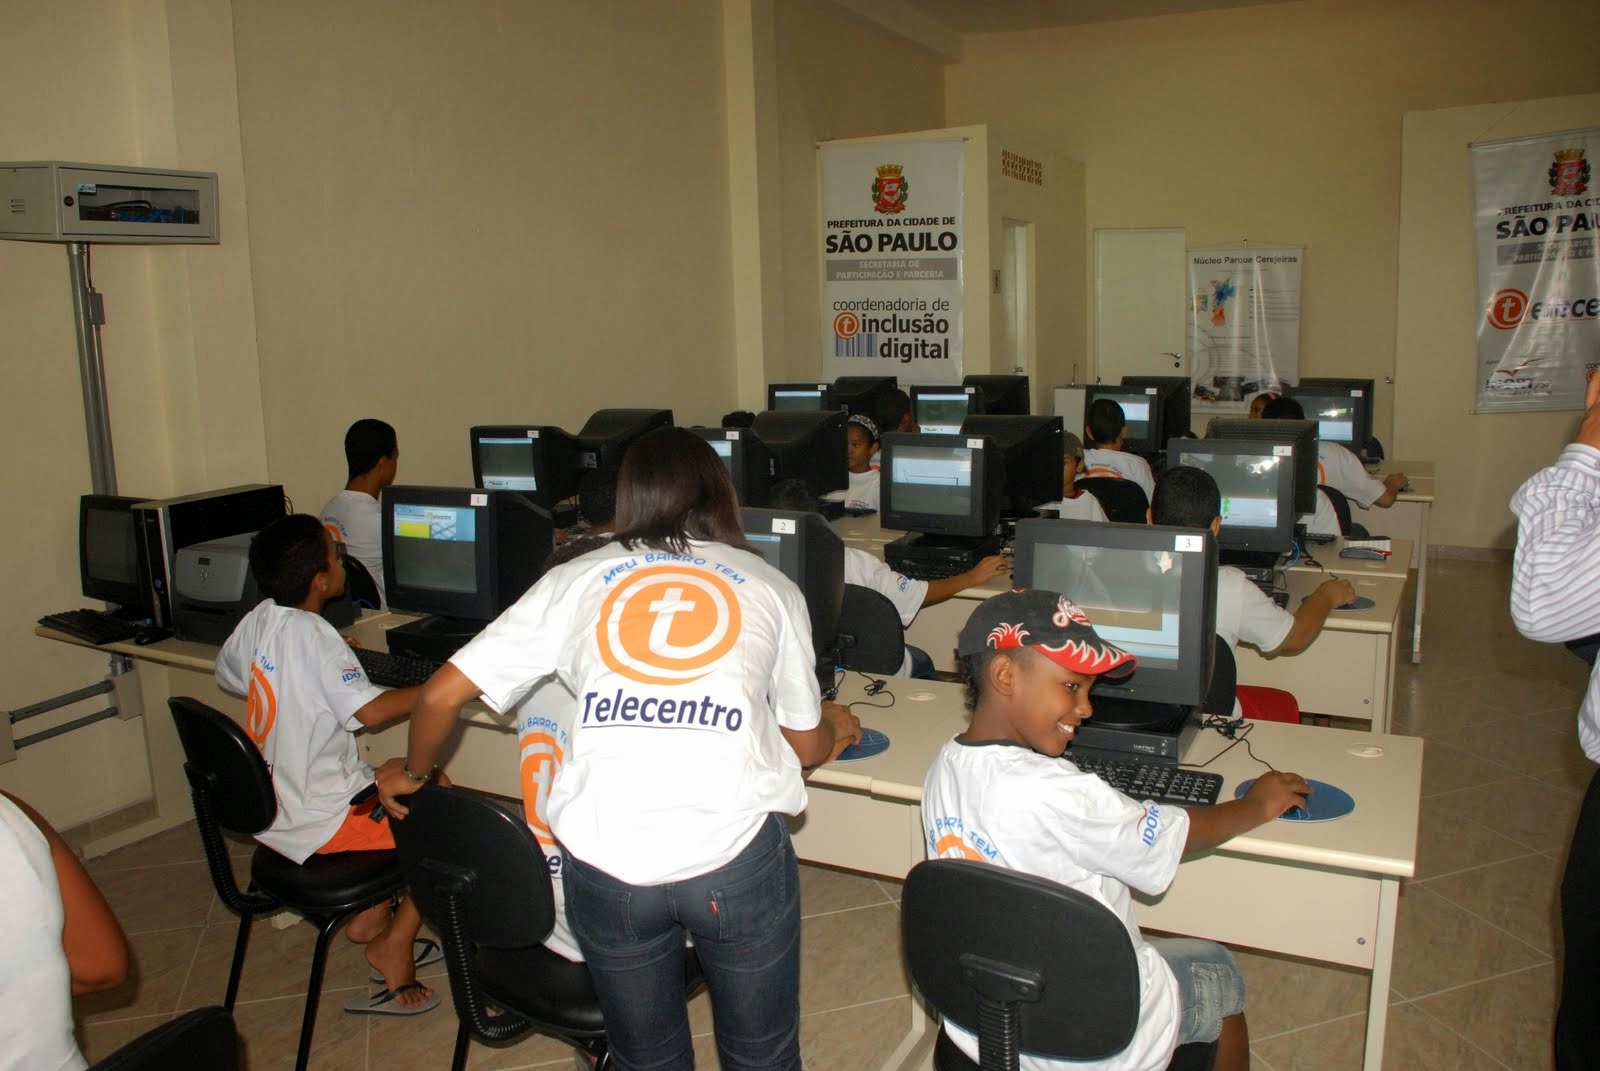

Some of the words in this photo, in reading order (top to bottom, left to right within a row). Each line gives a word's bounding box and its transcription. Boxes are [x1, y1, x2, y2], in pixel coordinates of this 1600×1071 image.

[1566, 200, 1583, 209] DA
[827, 219, 884, 229] PREFEITURA
[886, 218, 902, 227] DA
[903, 217, 940, 227] CIDADE
[942, 216, 956, 225] DE
[1496, 215, 1549, 240] SÃO
[826, 230, 873, 253] SÃO
[878, 231, 958, 252] PAULO
[859, 260, 906, 269] SECRETARIA
[909, 260, 920, 268] DE
[1193, 256, 1222, 265] Núcleo
[1224, 256, 1253, 265] Parque
[1255, 255, 1298, 265] Cerejeiras
[836, 270, 894, 281] PARTICIPAÇÃO
[896, 271, 901, 279] E
[903, 270, 945, 279] PARCERIA
[833, 297, 927, 311] coordenadoria
[932, 297, 950, 311] de
[862, 313, 949, 334] inclusão
[879, 337, 949, 364] digital
[1184, 538, 1192, 548] 3
[602, 558, 638, 585] MEU
[645, 553, 707, 566] BAIRRO
[713, 562, 746, 585] TEM
[582, 688, 743, 732] Telecentro
[970, 830, 998, 859] TEM
